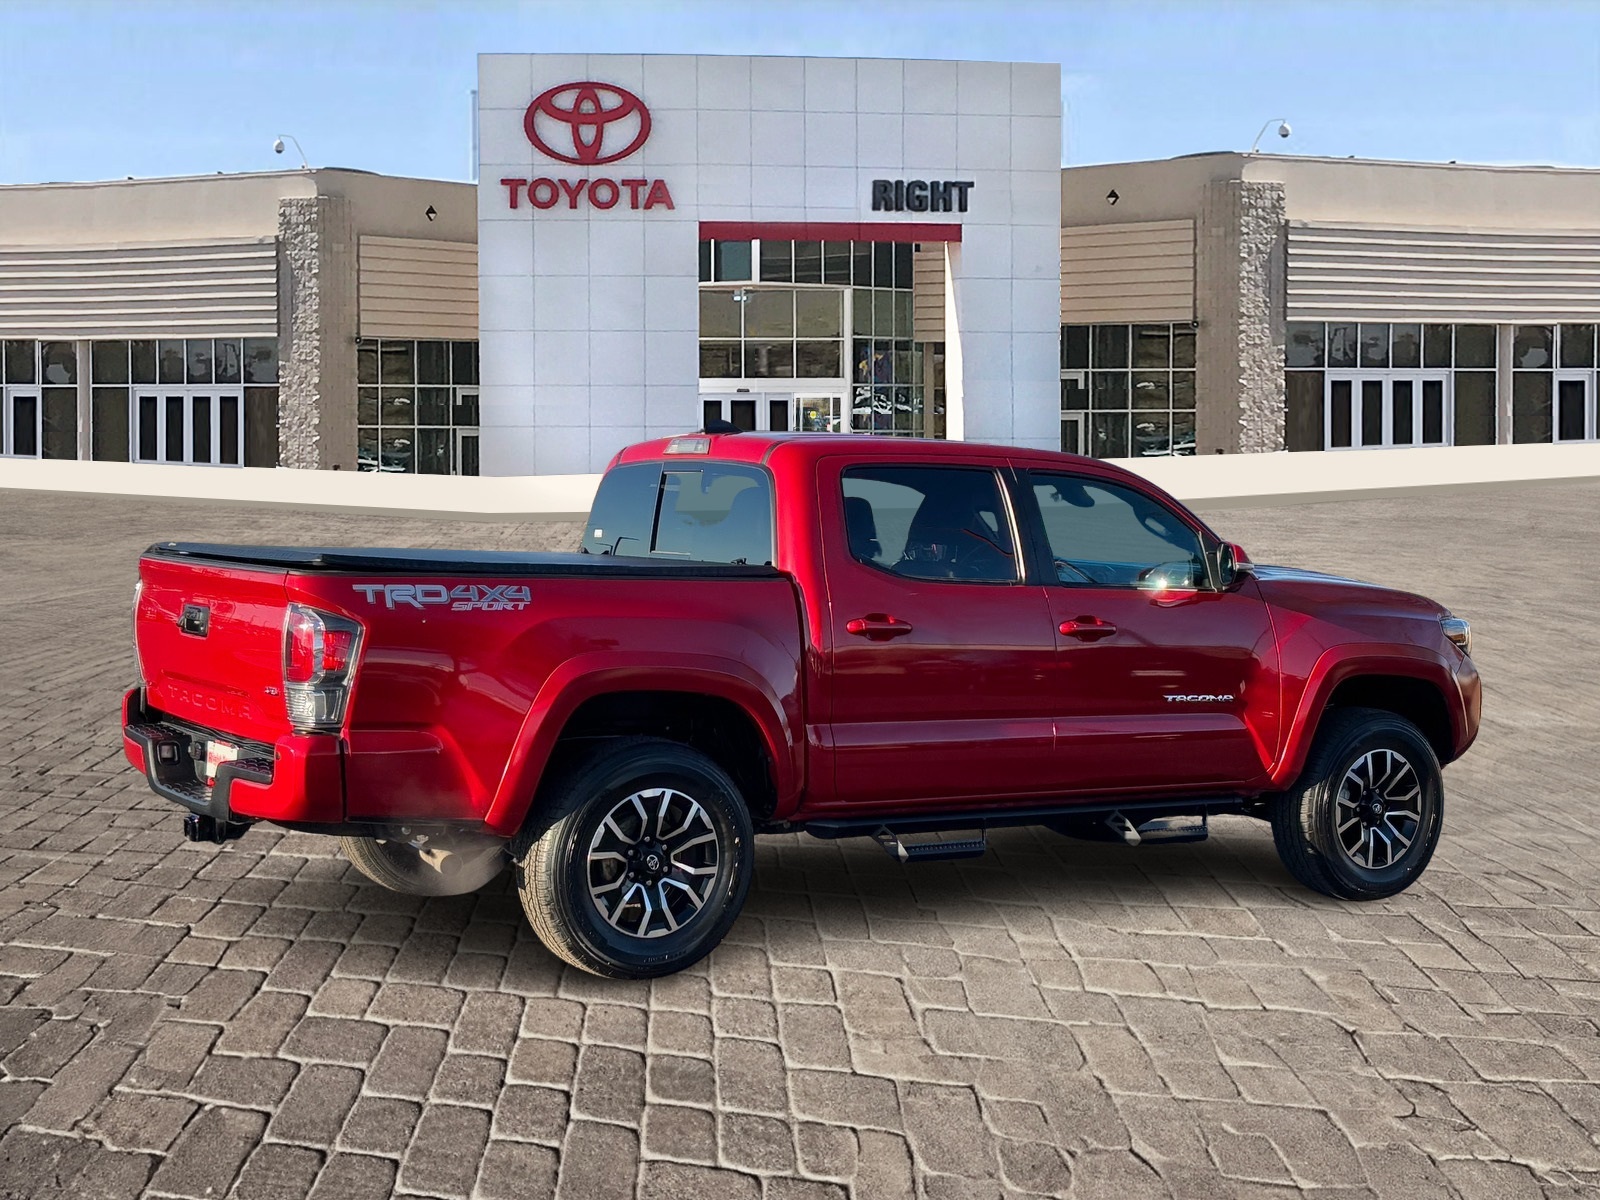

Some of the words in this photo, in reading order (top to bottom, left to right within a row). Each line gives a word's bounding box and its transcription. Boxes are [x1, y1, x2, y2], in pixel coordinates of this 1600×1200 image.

[500, 177, 675, 210] TOYOTA
[871, 179, 975, 213] RIGHT
[352, 584, 449, 610] TRD
[451, 601, 530, 611] SPORT
[167, 684, 253, 720] TACOMA
[1162, 694, 1234, 702] TACOMA
